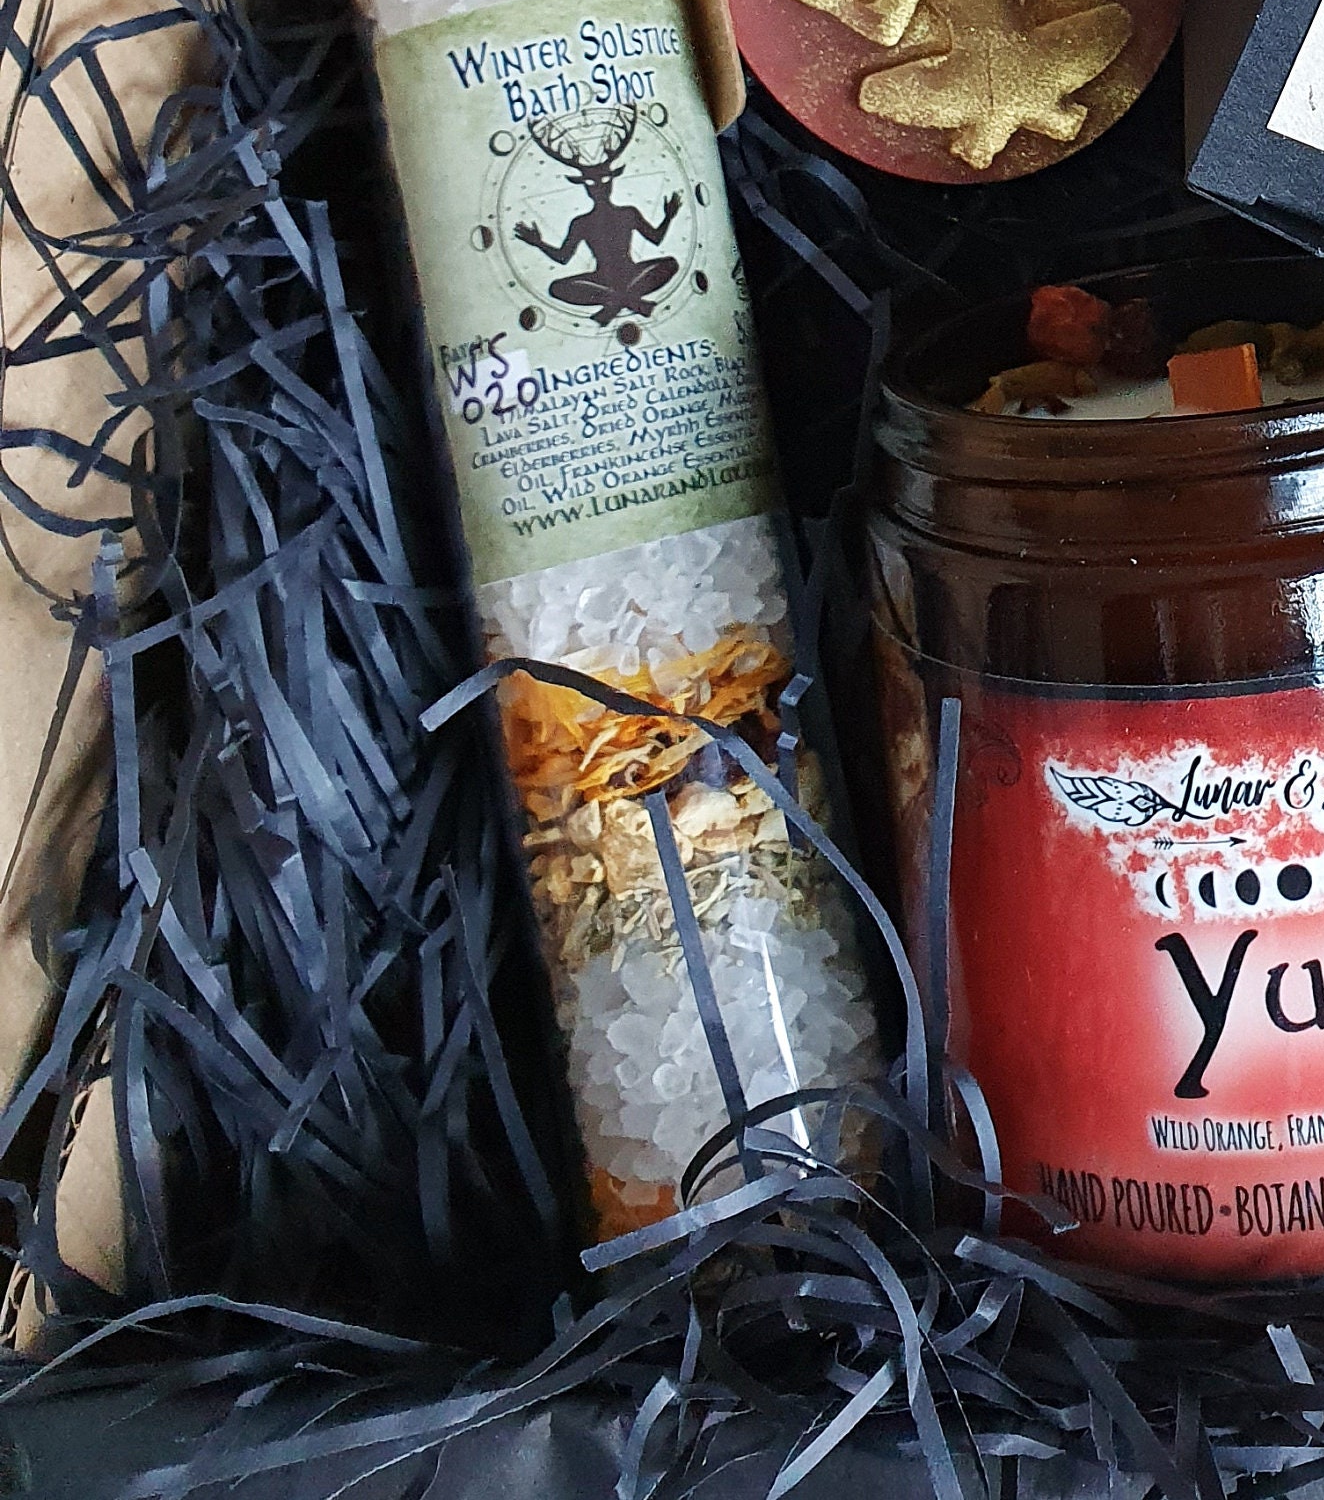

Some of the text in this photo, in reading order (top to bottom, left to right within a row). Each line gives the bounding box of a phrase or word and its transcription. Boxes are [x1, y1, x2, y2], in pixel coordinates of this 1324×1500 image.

[1172, 756, 1275, 823] Lunar
[1283, 759, 1317, 811] &
[1039, 1161, 1106, 1223] HAND
[1112, 1176, 1214, 1235] POURED
